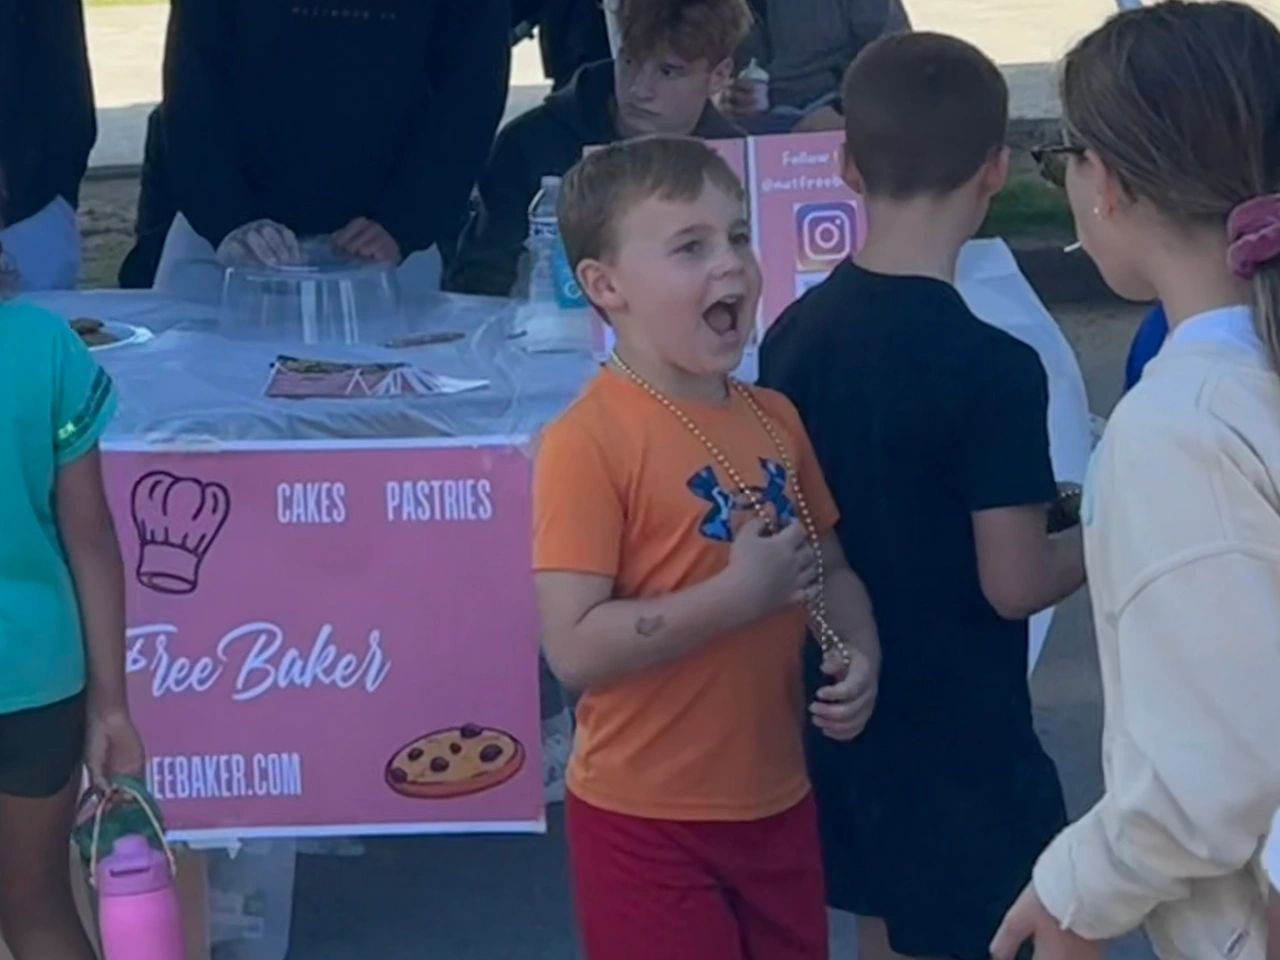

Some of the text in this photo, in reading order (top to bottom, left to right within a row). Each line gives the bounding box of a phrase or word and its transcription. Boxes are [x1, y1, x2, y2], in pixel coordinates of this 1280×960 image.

[276, 482, 346, 523] CAKES
[386, 479, 493, 522] PASTRIES
[217, 622, 392, 701] Baker
